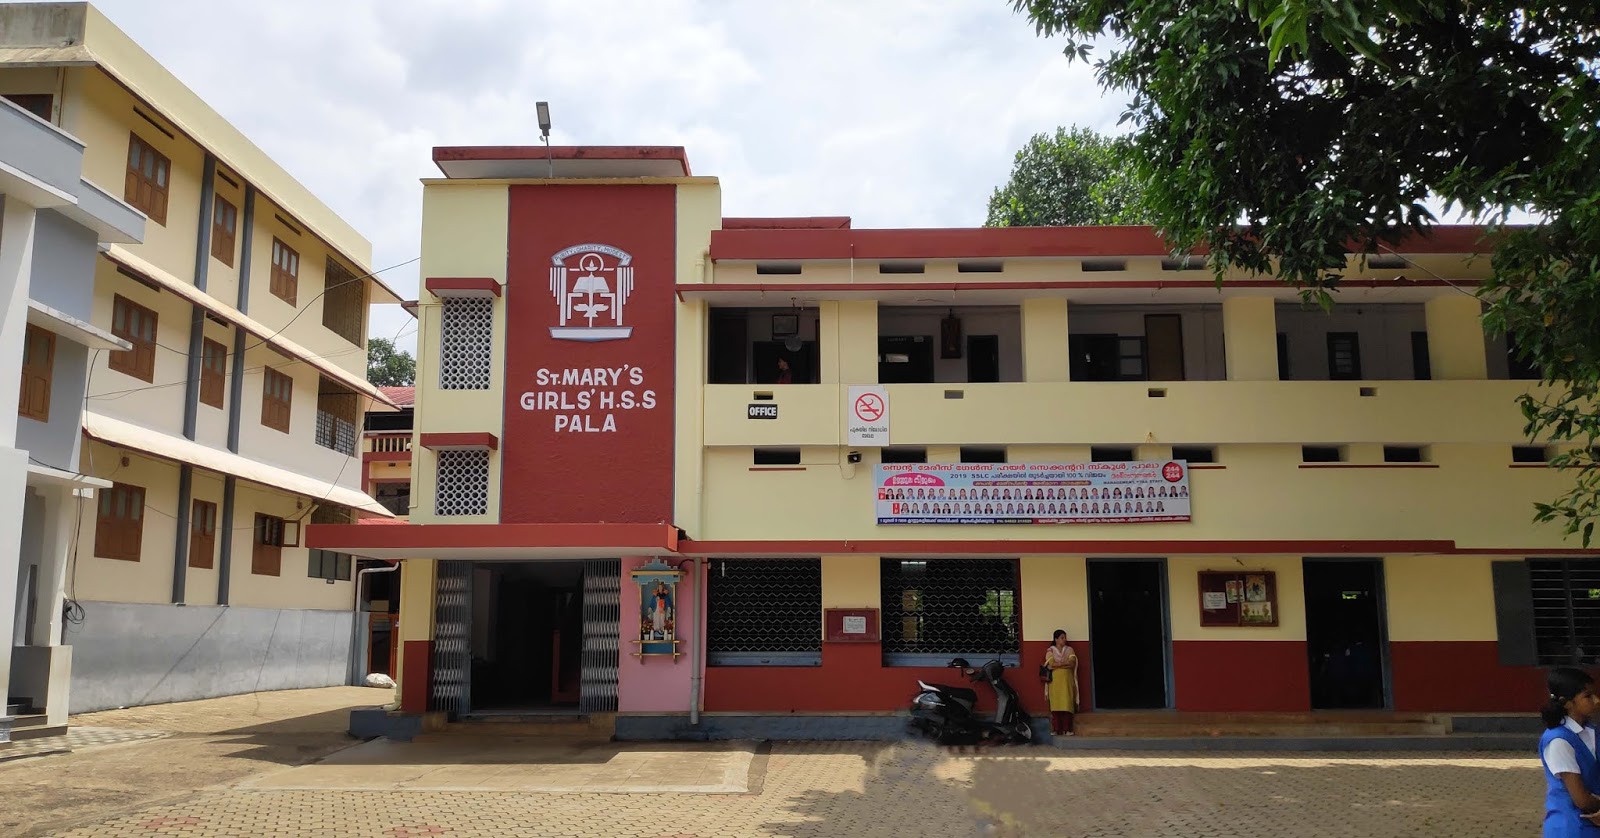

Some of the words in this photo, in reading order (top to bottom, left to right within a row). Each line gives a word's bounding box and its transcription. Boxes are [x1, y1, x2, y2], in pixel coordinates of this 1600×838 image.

[600, 390, 657, 410] H.S.S
[749, 406, 777, 416] OFFICE
[555, 413, 617, 433] PALA
